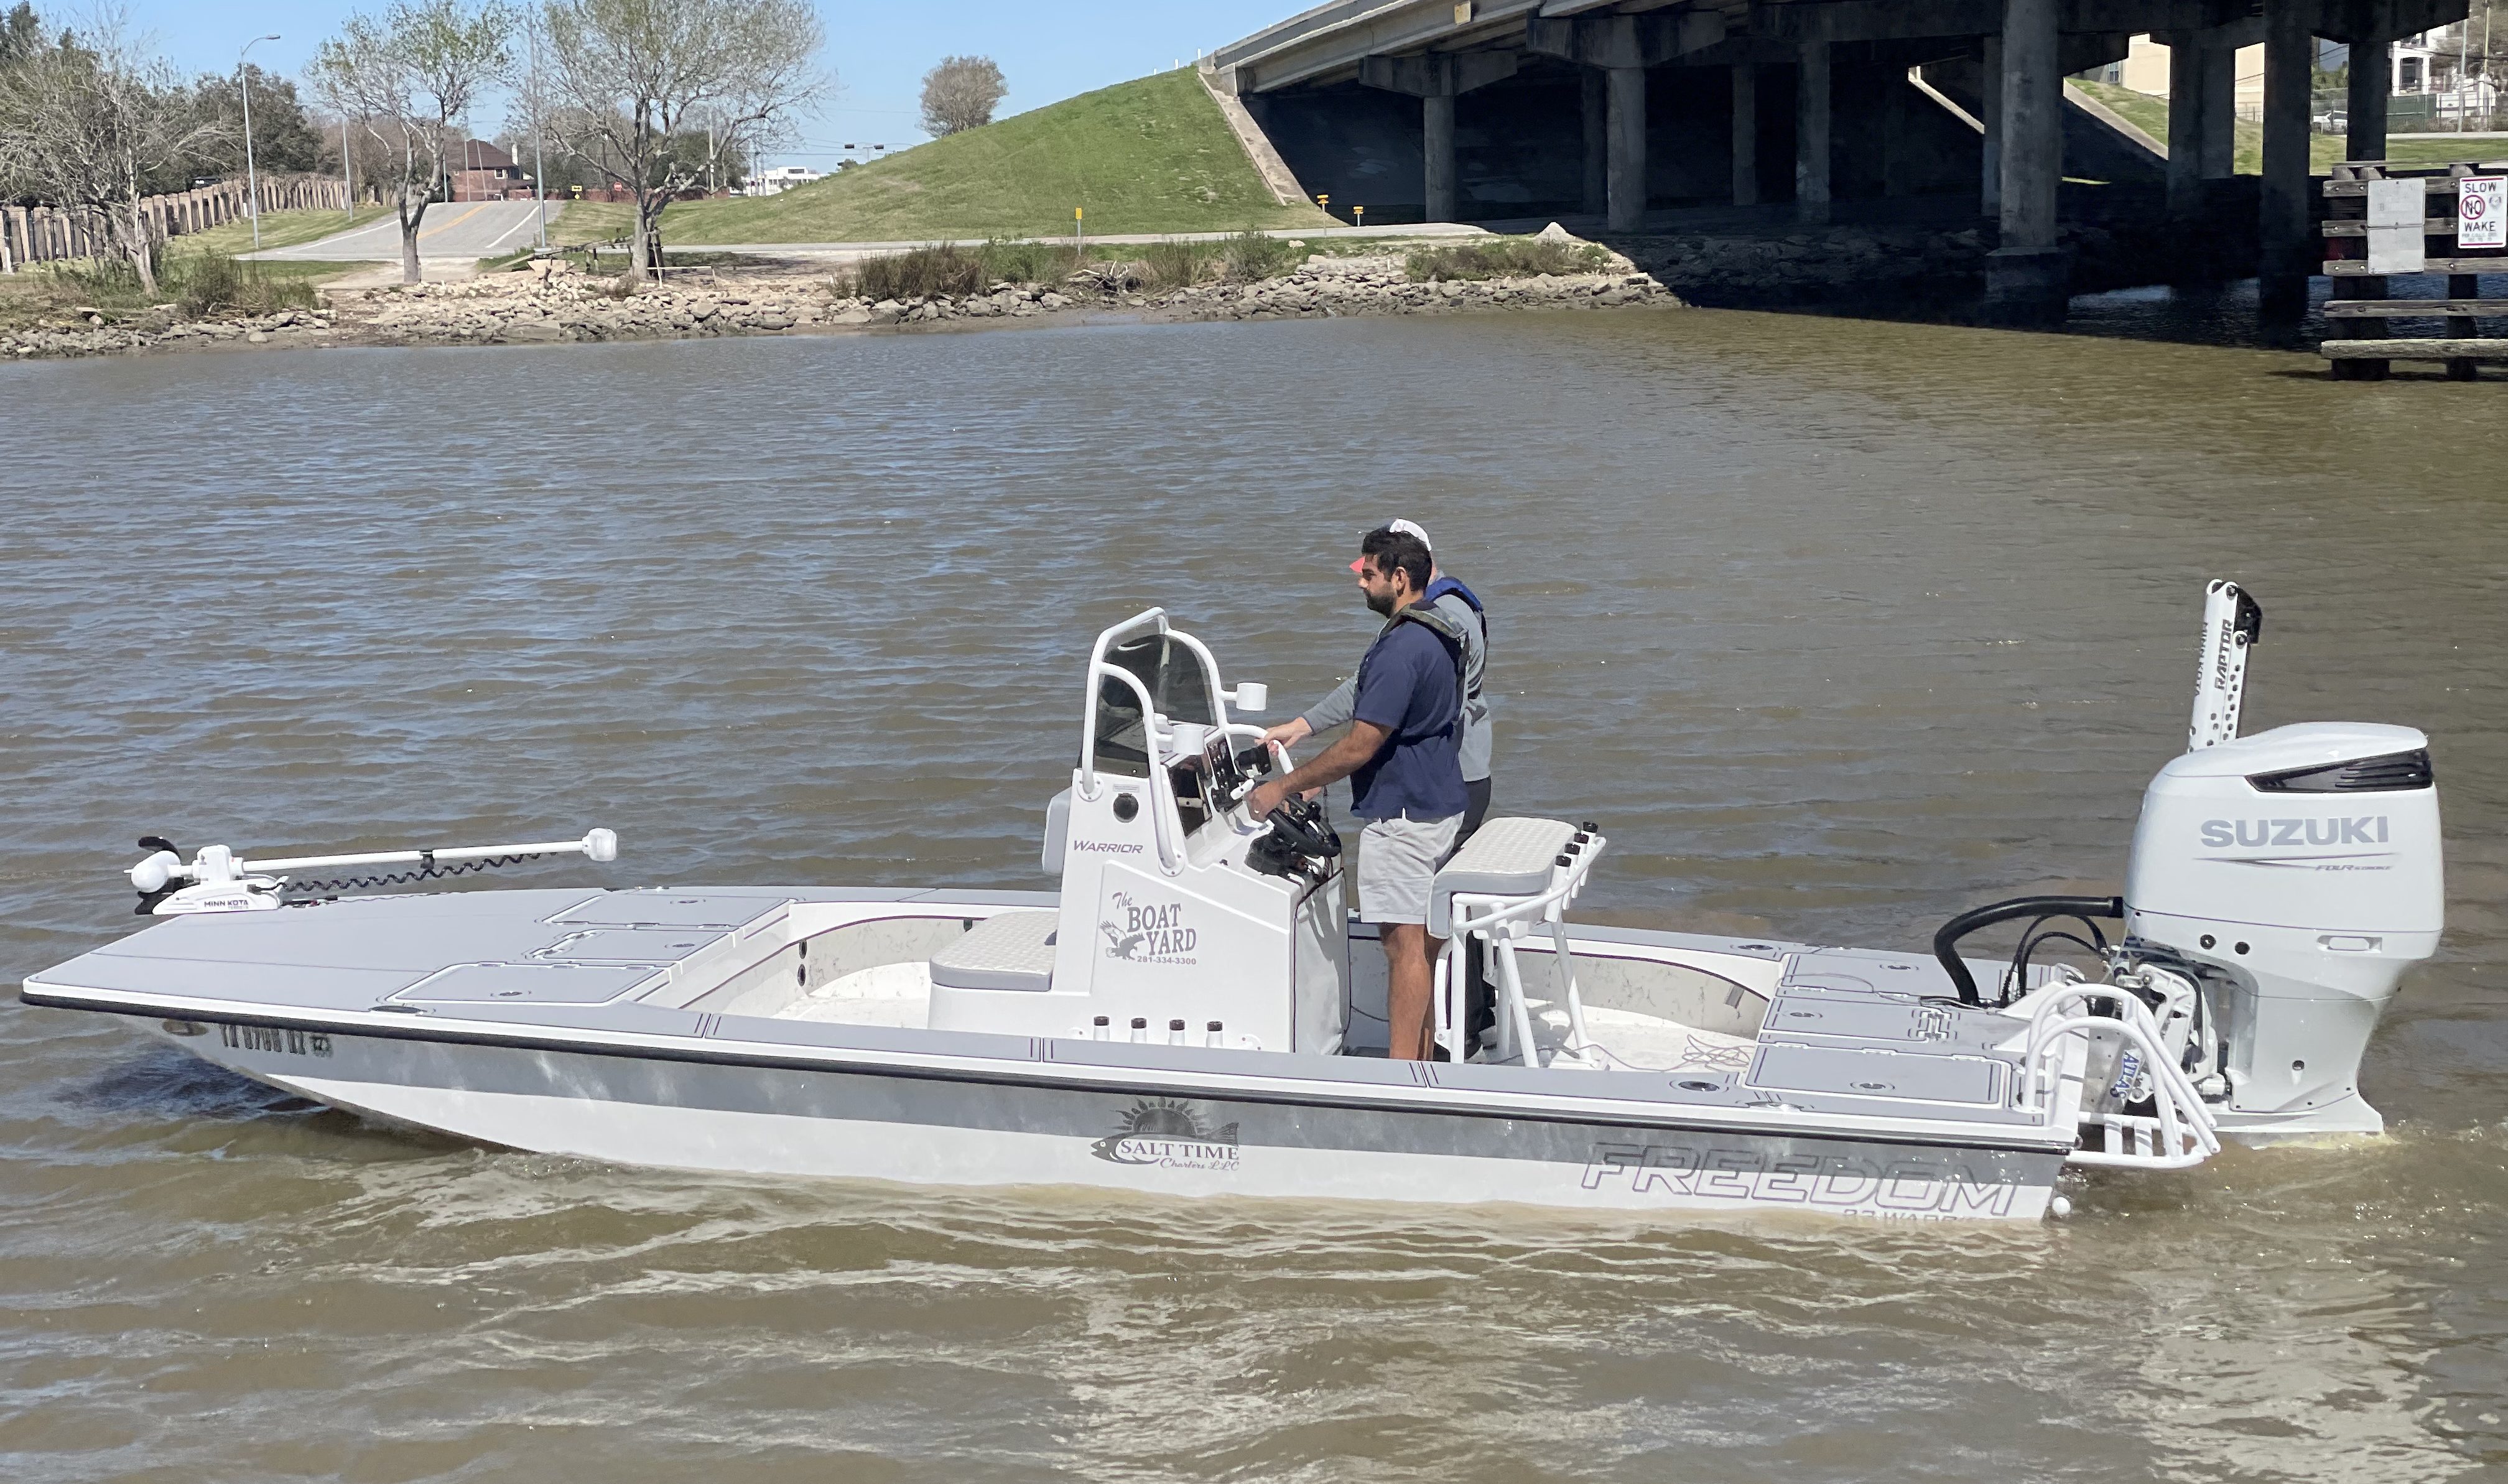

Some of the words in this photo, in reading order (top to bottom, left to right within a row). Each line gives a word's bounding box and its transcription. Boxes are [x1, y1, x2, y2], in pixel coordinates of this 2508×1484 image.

[2465, 182, 2496, 193] SLOW
[2465, 200, 2481, 215] NO
[2464, 221, 2496, 231] WAKE
[2214, 619, 2233, 690] RAPTOR
[2200, 816, 2388, 848] SUZUKI
[1074, 840, 1143, 854] WARRIOR
[1112, 891, 1133, 909] The
[1127, 903, 1181, 932] BOAT
[1146, 929, 1197, 955] YARD
[1137, 955, 1196, 965] 281-334-3300
[1120, 1141, 1174, 1156] SALT
[1179, 1144, 1239, 1160] TIME
[1160, 1157, 1205, 1169] Charters
[1581, 1142, 2024, 1217] FREEDOM
